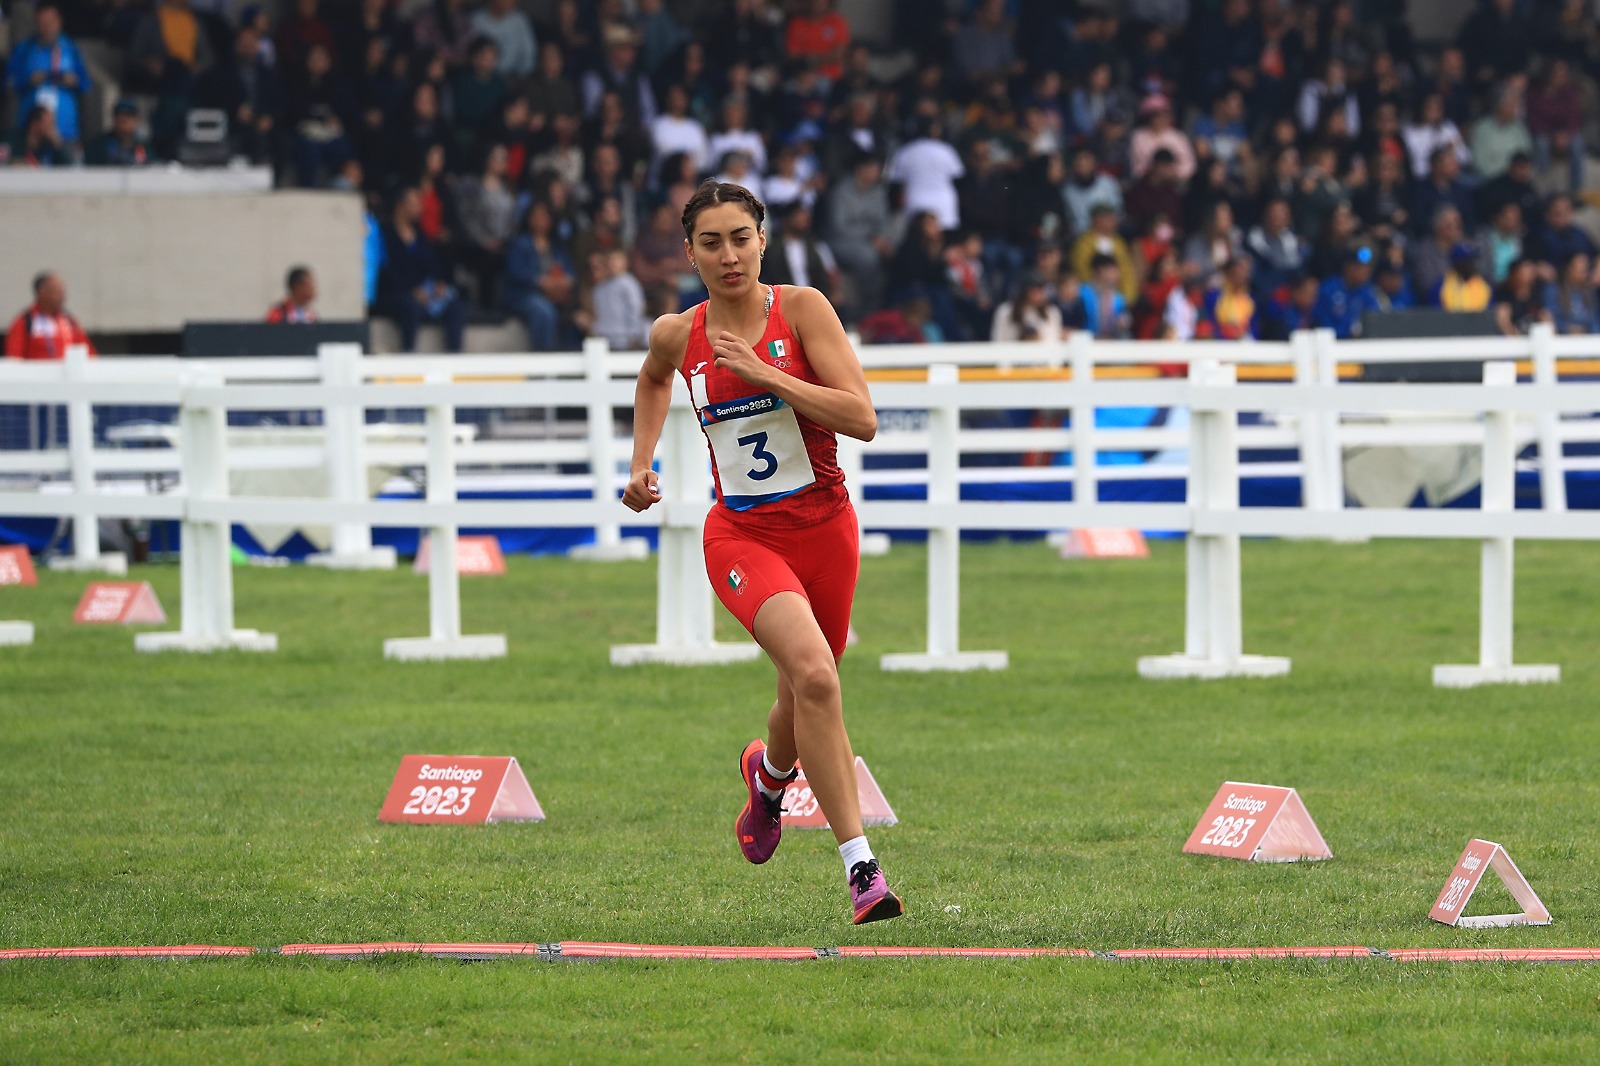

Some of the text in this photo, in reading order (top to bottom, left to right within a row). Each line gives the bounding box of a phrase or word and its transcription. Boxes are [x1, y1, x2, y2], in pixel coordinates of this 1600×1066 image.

[737, 431, 778, 481] 3
[417, 763, 483, 784] Santiago
[402, 785, 476, 816] 2023
[1223, 792, 1267, 815] Santiago
[1200, 815, 1256, 848] 2023
[1438, 875, 1470, 912] 2023
